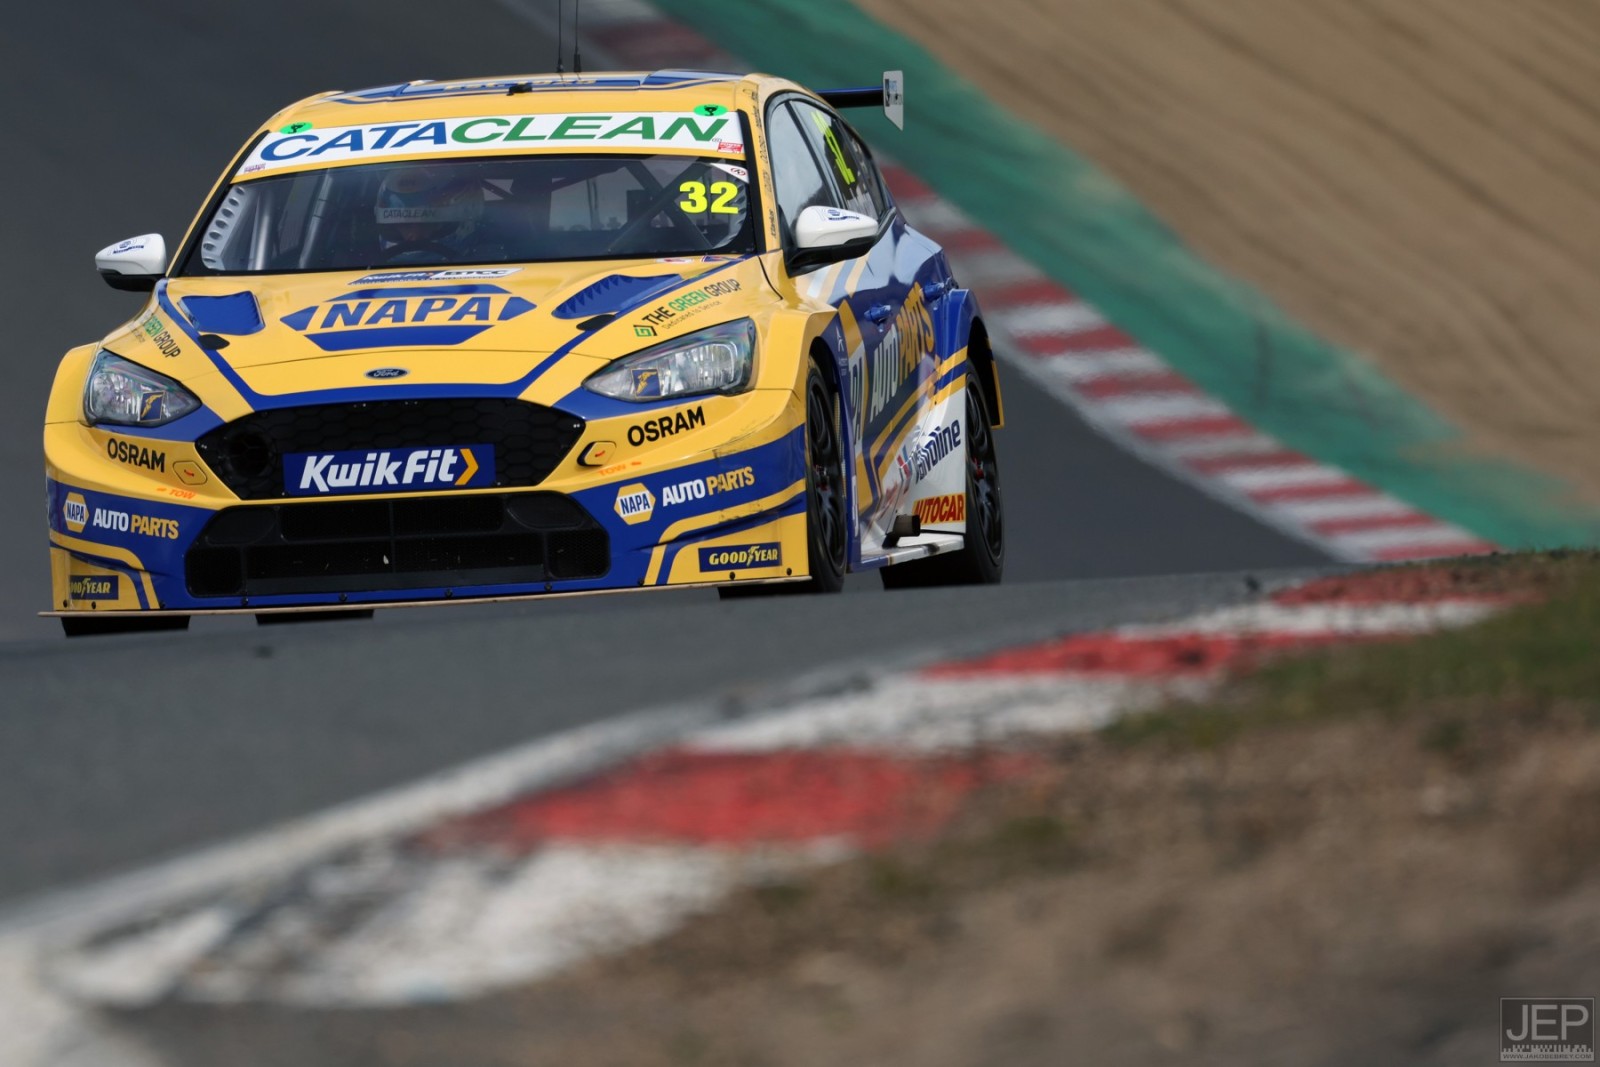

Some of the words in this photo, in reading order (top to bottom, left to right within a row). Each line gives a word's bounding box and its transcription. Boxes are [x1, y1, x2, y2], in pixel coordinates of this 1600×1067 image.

[260, 115, 729, 161] CATACLEAN
[679, 180, 739, 214] 32
[320, 297, 491, 328] NAPA
[642, 306, 676, 325] THE
[668, 289, 711, 312] GREEN
[703, 278, 742, 297] GROUP
[153, 330, 182, 357] GROUP
[373, 369, 400, 377] Ford
[869, 322, 899, 423] AUTO
[627, 406, 706, 446] OSRAM
[107, 438, 165, 472] OSRAM
[169, 489, 196, 499] TOW
[619, 492, 650, 515] NAPA
[662, 479, 706, 507] AUTO
[706, 466, 755, 495] PARTS
[66, 505, 86, 522] NAPA
[92, 508, 129, 531] AUTO
[130, 514, 179, 539] PARTS
[914, 494, 965, 523] AUTOCAR
[709, 546, 778, 566] GOODYEAR
[70, 578, 111, 597] OODYEAR
